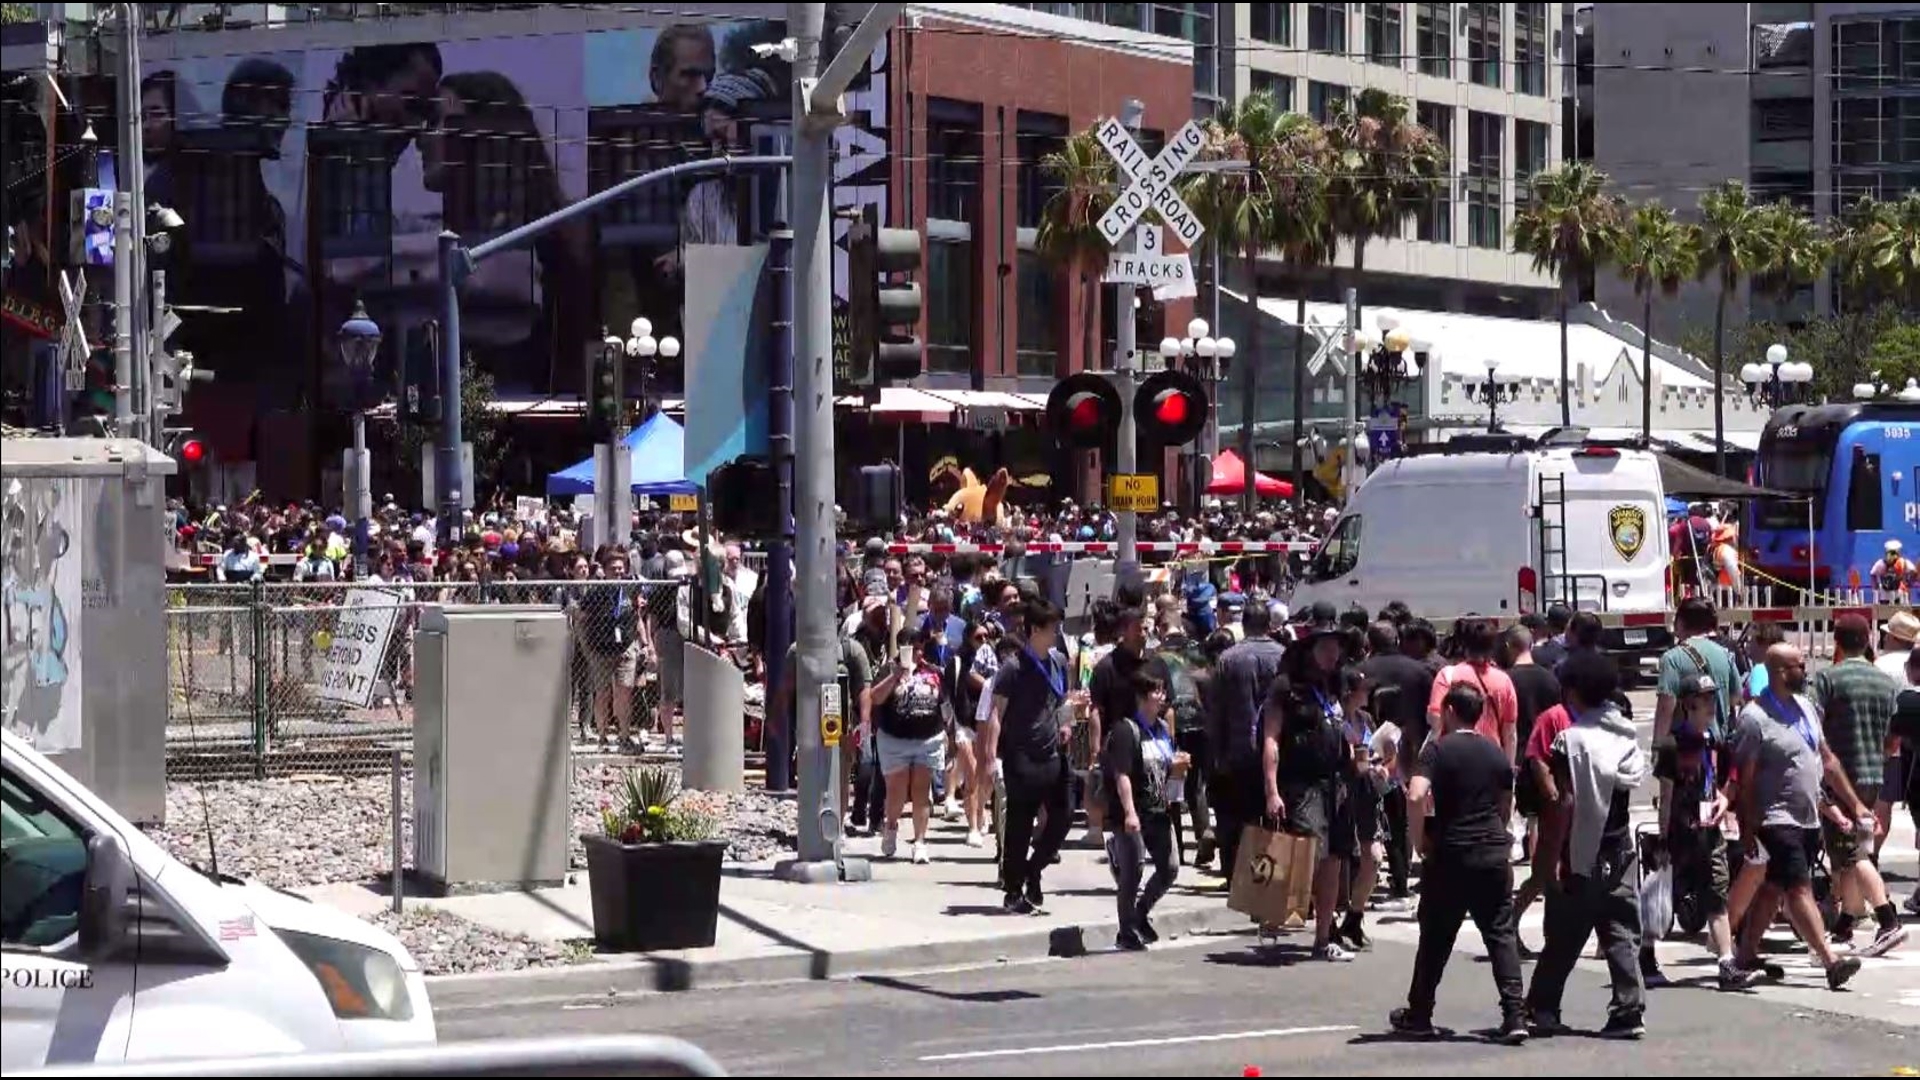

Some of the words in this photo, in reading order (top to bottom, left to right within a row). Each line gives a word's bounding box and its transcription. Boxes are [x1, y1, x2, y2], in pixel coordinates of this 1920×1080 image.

[833, 28, 887, 303] TAR
[1102, 122, 1144, 178] RAIL
[1154, 186, 1198, 239] ROAD
[1103, 127, 1200, 237] CROSSING
[1144, 230, 1156, 251] 3
[1113, 258, 1184, 279] TRACKS
[1884, 426, 1911, 440] 5035
[1125, 479, 1141, 491] NO
